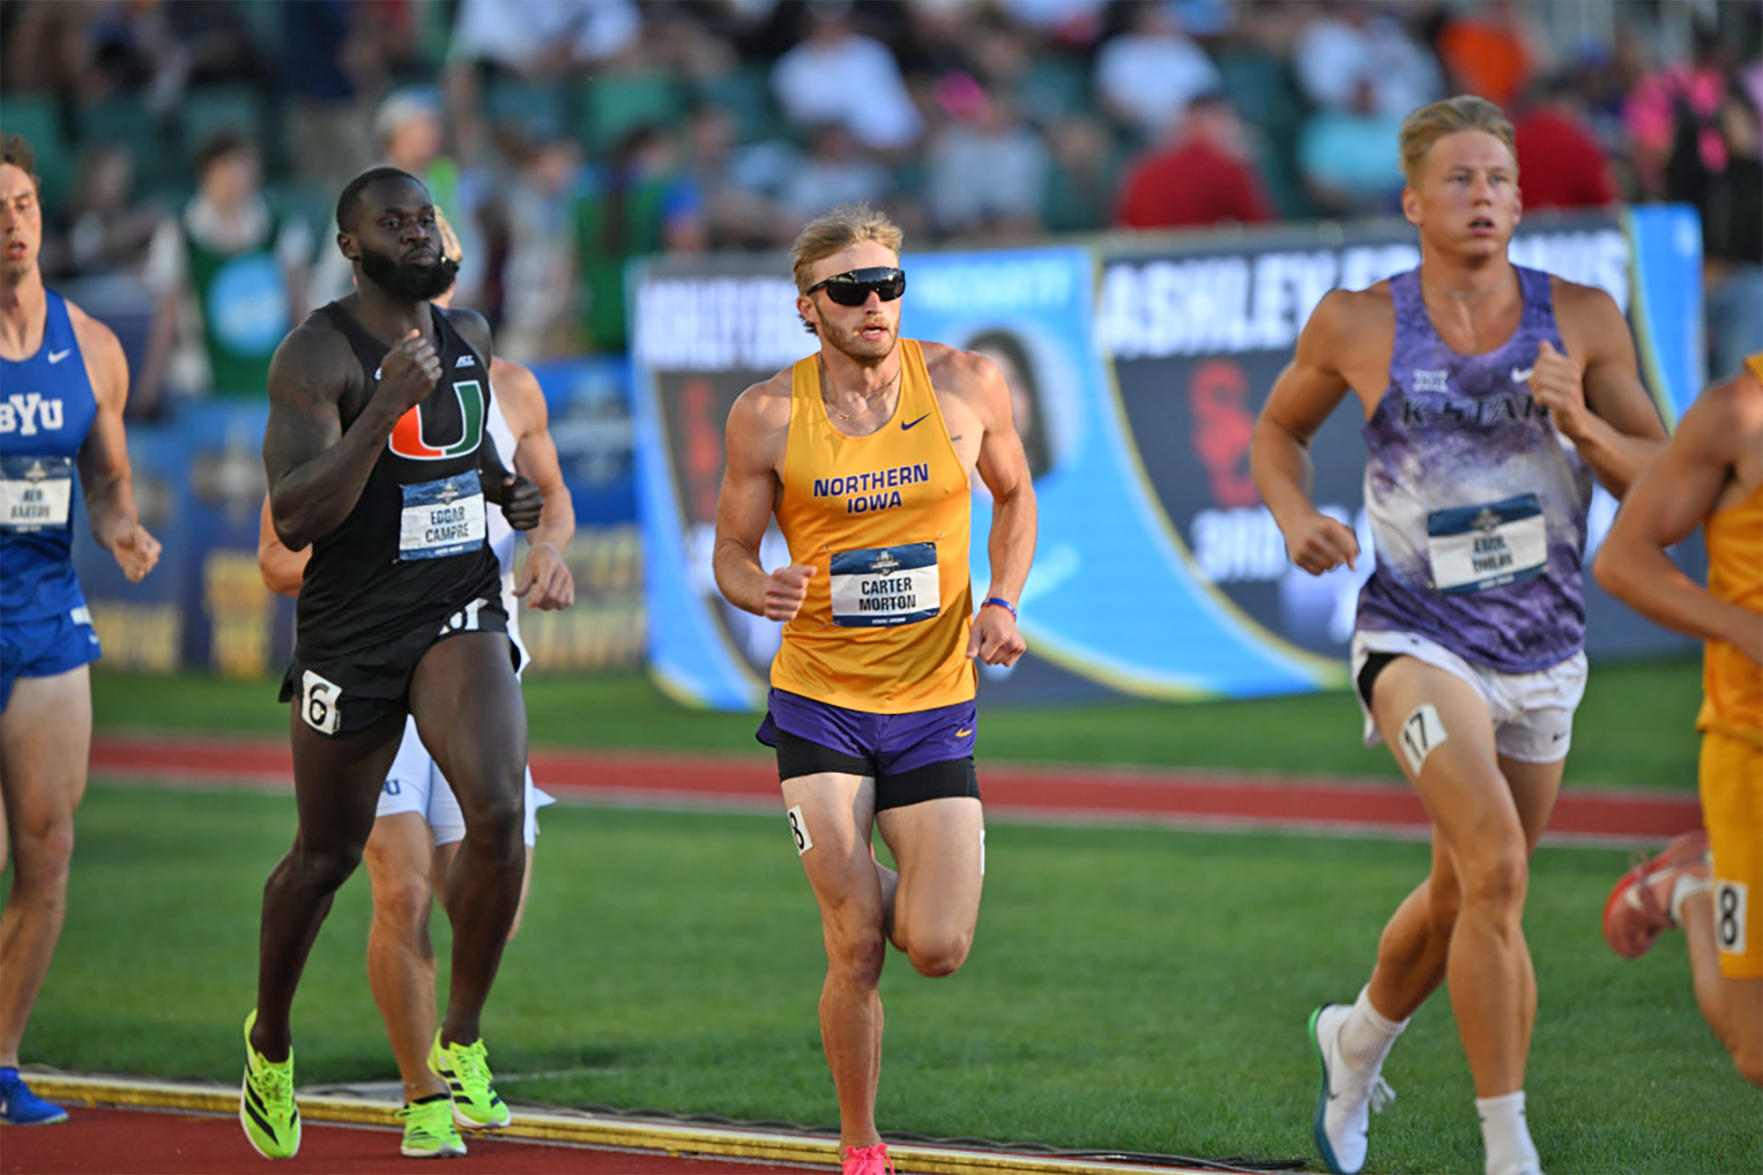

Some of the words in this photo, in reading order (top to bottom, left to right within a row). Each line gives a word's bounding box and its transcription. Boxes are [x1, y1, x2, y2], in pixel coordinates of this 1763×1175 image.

[0, 392, 63, 435] BYU
[813, 463, 929, 497] NORTHERN
[430, 505, 465, 525] EDGAR
[847, 490, 903, 514] IOWA
[858, 594, 916, 612] MORTON
[861, 577, 912, 596] CARTER
[309, 682, 328, 727] 6
[1404, 710, 1429, 761] 17
[1720, 887, 1738, 946] 8
